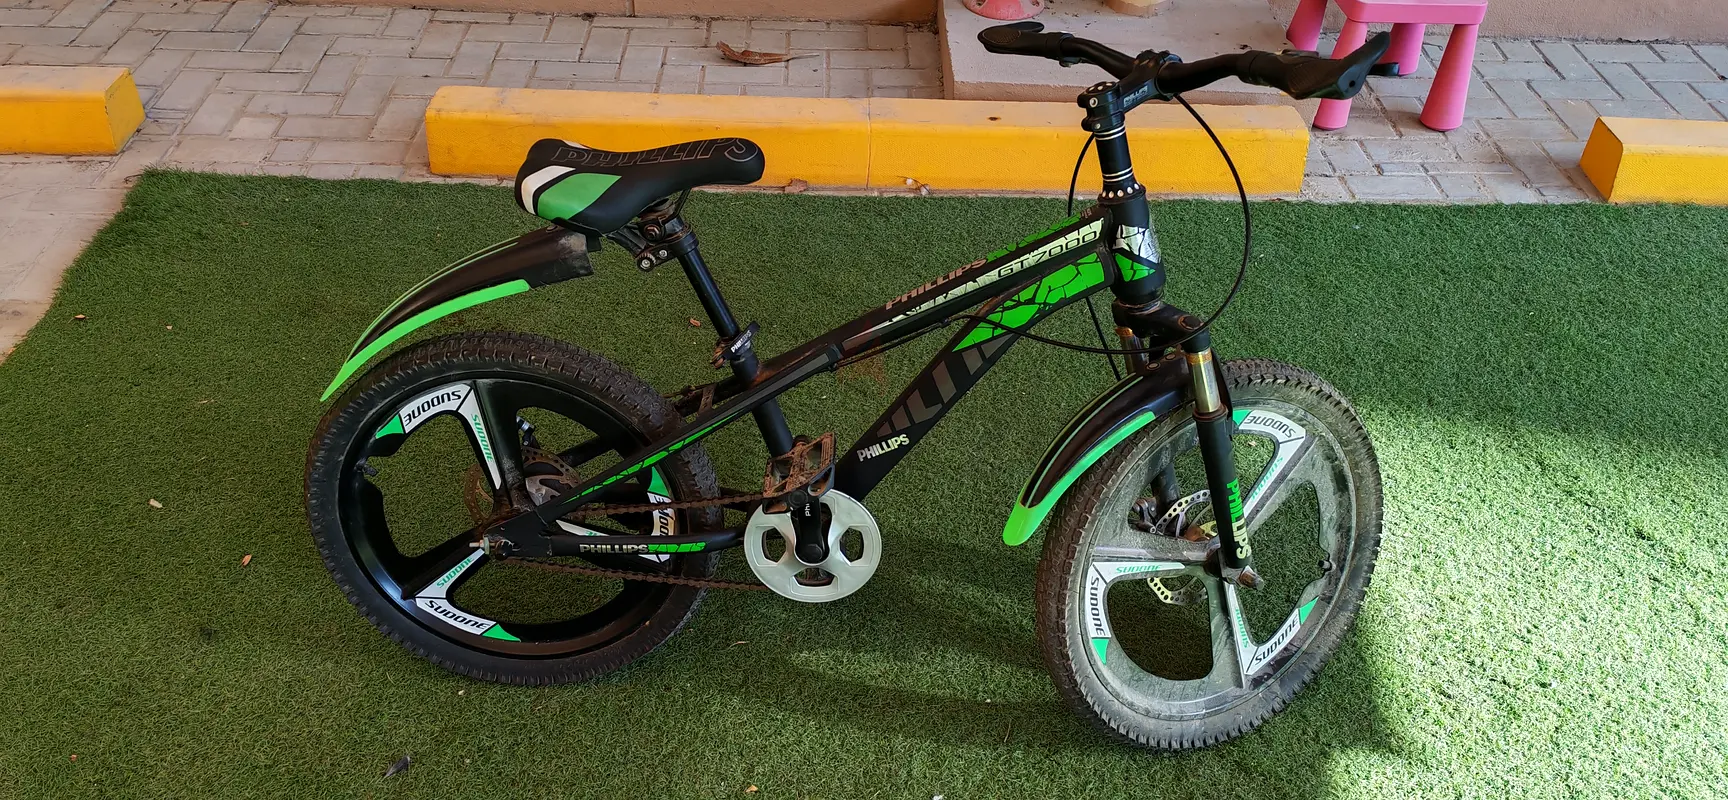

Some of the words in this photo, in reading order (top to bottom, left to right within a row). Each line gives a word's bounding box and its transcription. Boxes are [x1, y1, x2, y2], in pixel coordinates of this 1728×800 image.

[551, 137, 759, 167] PHILLIPS
[885, 258, 987, 311] PHILLIPS
[403, 389, 462, 427] SUDONE
[471, 413, 494, 462] SUDONE
[1243, 414, 1297, 439] SUDONE
[857, 433, 910, 462] PHILLIPS
[1226, 477, 1252, 561] PHILLIPS
[580, 544, 649, 554] PHILLIPS
[436, 556, 475, 589] SUDONE
[424, 600, 491, 631] SUDONE
[1090, 575, 1107, 636] SUDONE
[1253, 613, 1299, 667] SUDONE
